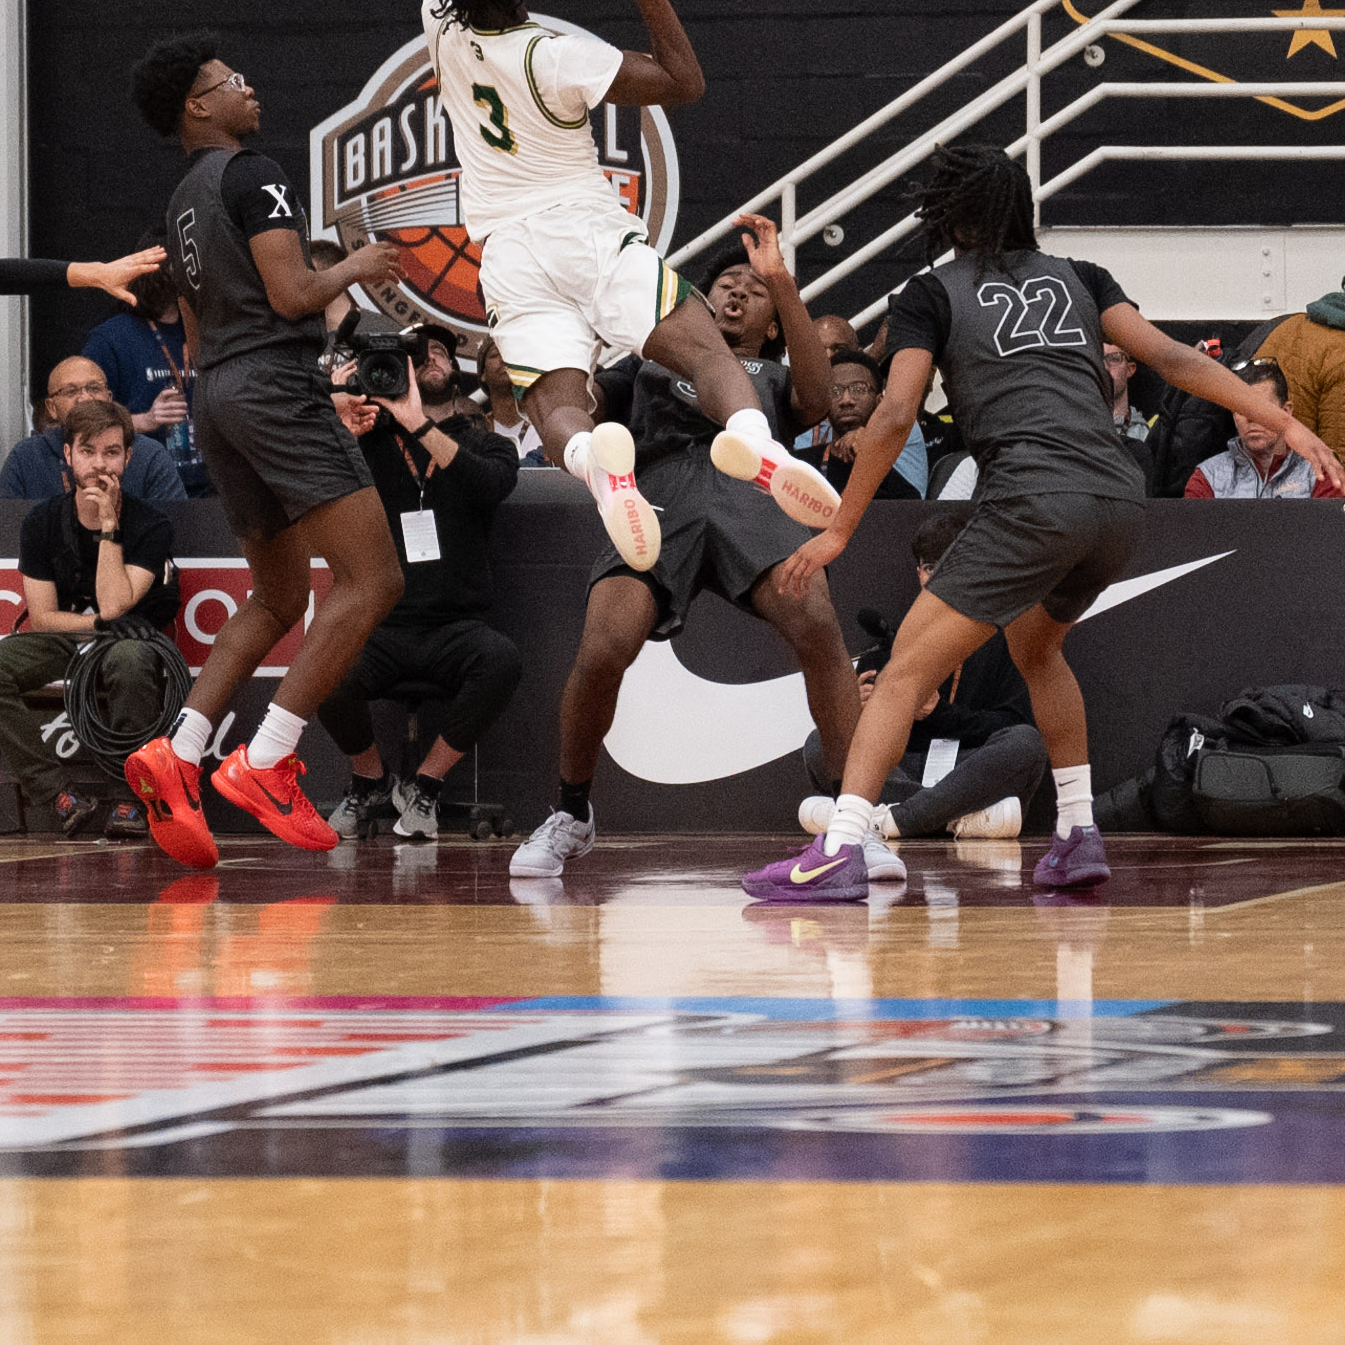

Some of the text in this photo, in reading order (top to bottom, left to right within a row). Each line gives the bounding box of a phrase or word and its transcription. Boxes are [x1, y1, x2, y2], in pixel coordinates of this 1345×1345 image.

[471, 82, 519, 155] 3
[260, 183, 293, 219] X
[176, 207, 202, 291] 5
[976, 275, 1087, 357] 22
[623, 498, 648, 556] HARIBO
[781, 479, 834, 518] HARIBO
